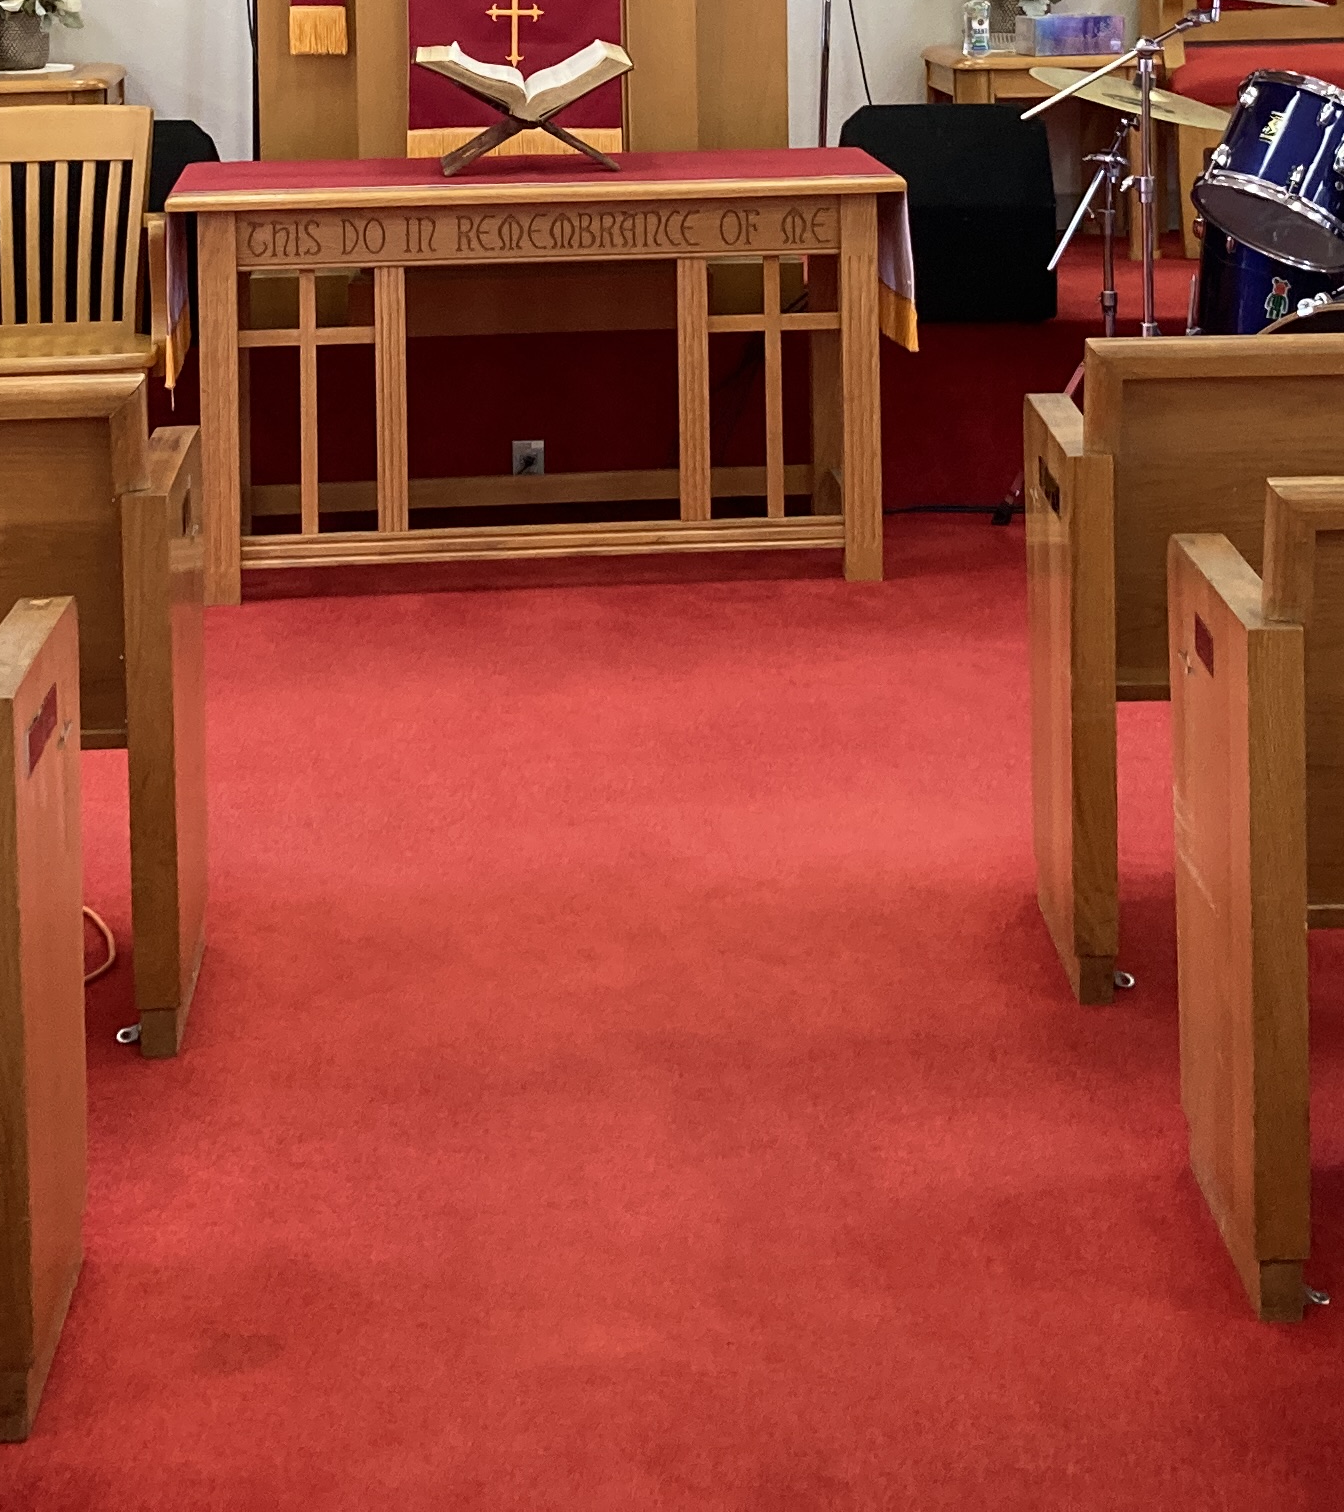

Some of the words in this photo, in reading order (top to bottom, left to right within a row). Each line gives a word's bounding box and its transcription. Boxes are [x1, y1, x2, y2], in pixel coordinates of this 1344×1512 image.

[247, 219, 322, 258] THIS
[341, 217, 386, 255] DO
[404, 215, 436, 253] IN
[456, 209, 700, 253] REMEMBRANCE
[719, 209, 760, 246] OF
[781, 207, 831, 245] ME
